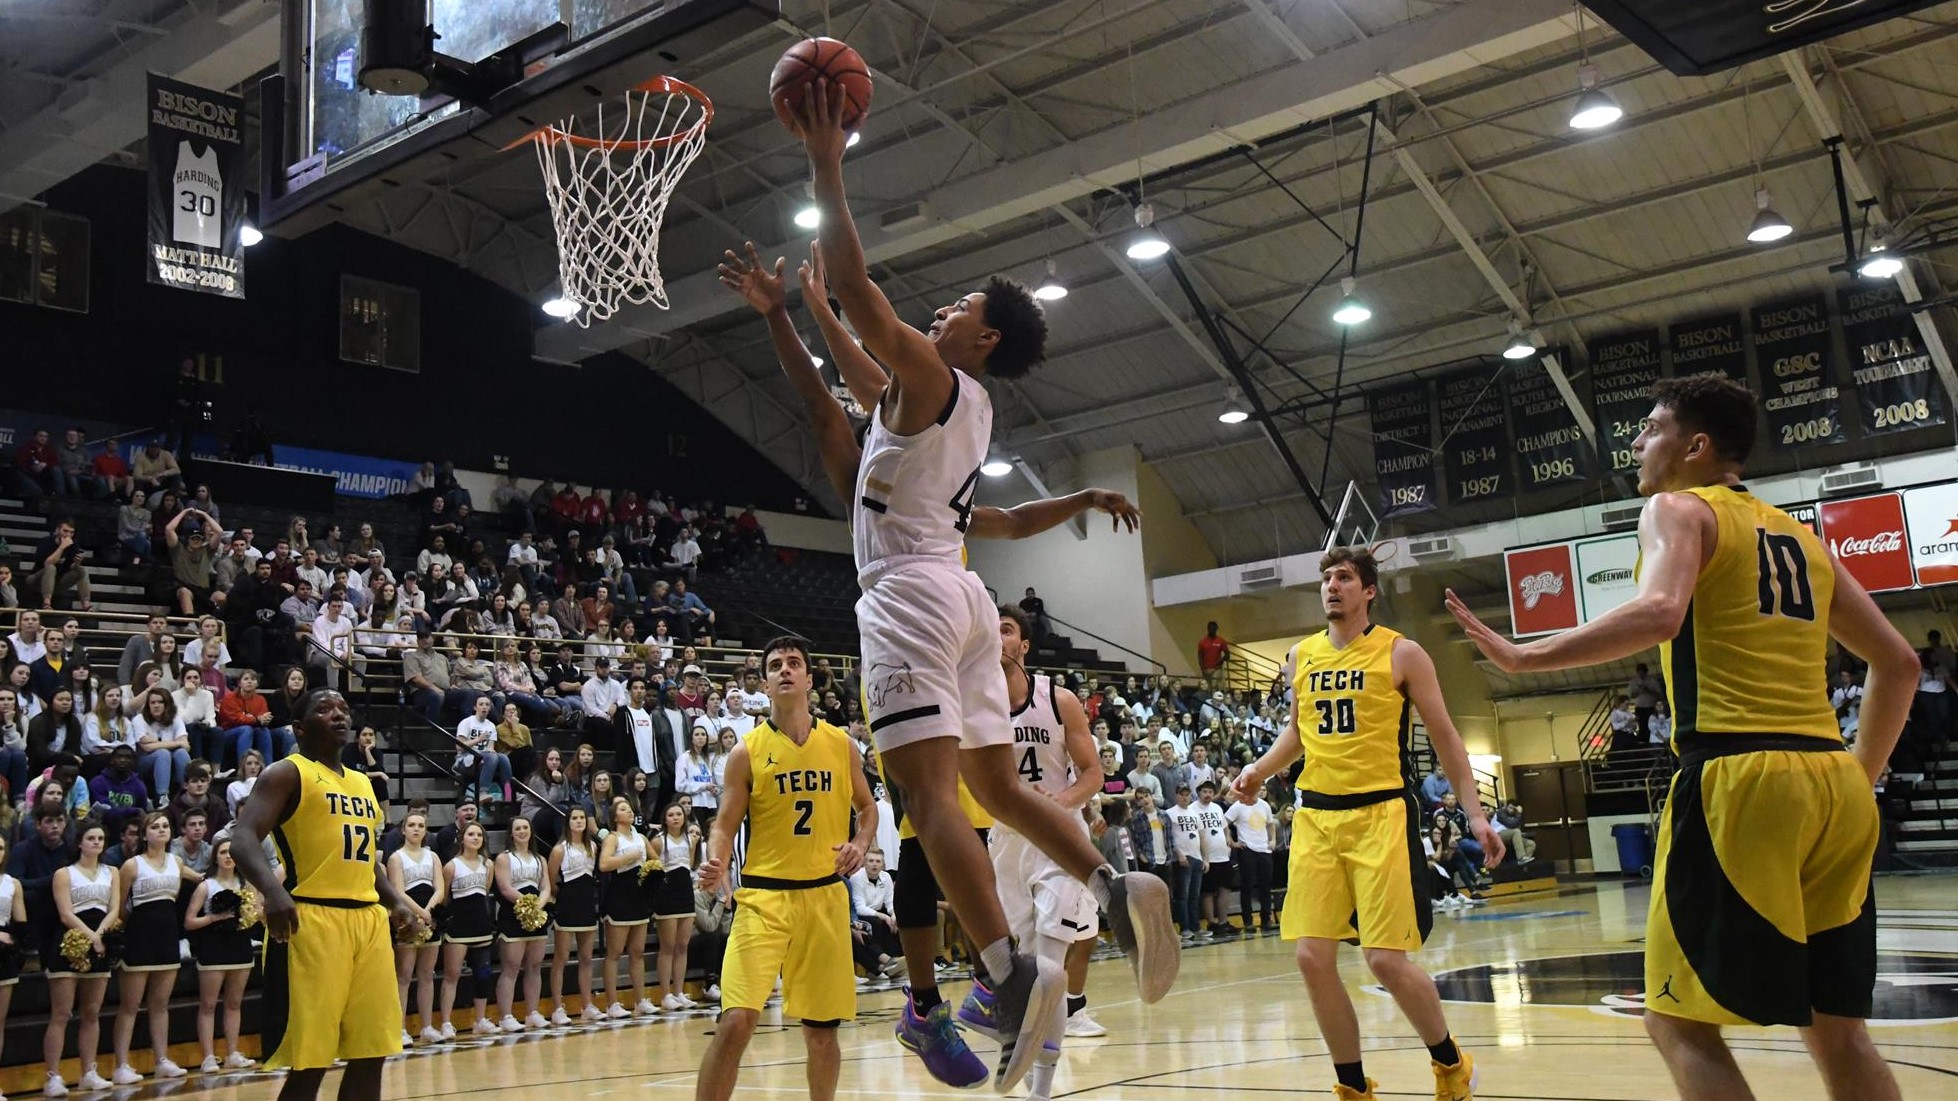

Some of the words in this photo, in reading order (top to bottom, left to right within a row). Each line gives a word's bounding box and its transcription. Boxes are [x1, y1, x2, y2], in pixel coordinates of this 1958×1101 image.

[157, 88, 237, 126] BISON
[152, 109, 240, 144] BASKETBALL
[176, 169, 220, 192] HARDING
[180, 190, 215, 217] 30
[155, 243, 199, 265] MATT
[200, 251, 238, 274] HALL
[1760, 303, 1818, 329] BISON
[1677, 325, 1734, 349] BISON
[1754, 320, 1830, 345] BASKETBALL
[1599, 340, 1650, 361] BISON
[1672, 341, 1745, 364] BASKETBALL
[1861, 336, 1917, 365] NCAA
[1592, 355, 1660, 376] BASKETBALL
[1773, 352, 1822, 377] GSC
[1853, 354, 1932, 386] TOURNAMENT
[1594, 370, 1660, 391] NATIONAL
[1780, 376, 1821, 394] WEST
[1765, 386, 1839, 411] CHAMPIONS
[1873, 398, 1930, 429] 2008
[1516, 425, 1581, 454] CHAMPIONS
[1781, 417, 1832, 445] 2008
[666, 431, 688, 458] 12
[1461, 446, 1496, 465] 18-14
[1376, 453, 1430, 475] CHAMPION
[1531, 457, 1575, 483] 1996
[948, 461, 982, 534] 4
[1390, 484, 1426, 507] 1987
[1460, 475, 1500, 498] 1987
[1840, 530, 1903, 558] Coca-Cola
[1592, 569, 1633, 583] GREENWAY
[1757, 528, 1815, 621] 10
[1309, 670, 1364, 692] TECH
[1315, 699, 1355, 734] 30
[1014, 726, 1050, 744] DING
[1018, 746, 1043, 782] 4
[774, 770, 832, 794] TECH
[326, 793, 376, 819] TECH
[794, 800, 813, 835] 2
[1199, 812, 1219, 820] BEAT
[1202, 820, 1222, 828] TECH
[343, 824, 370, 862] 12
